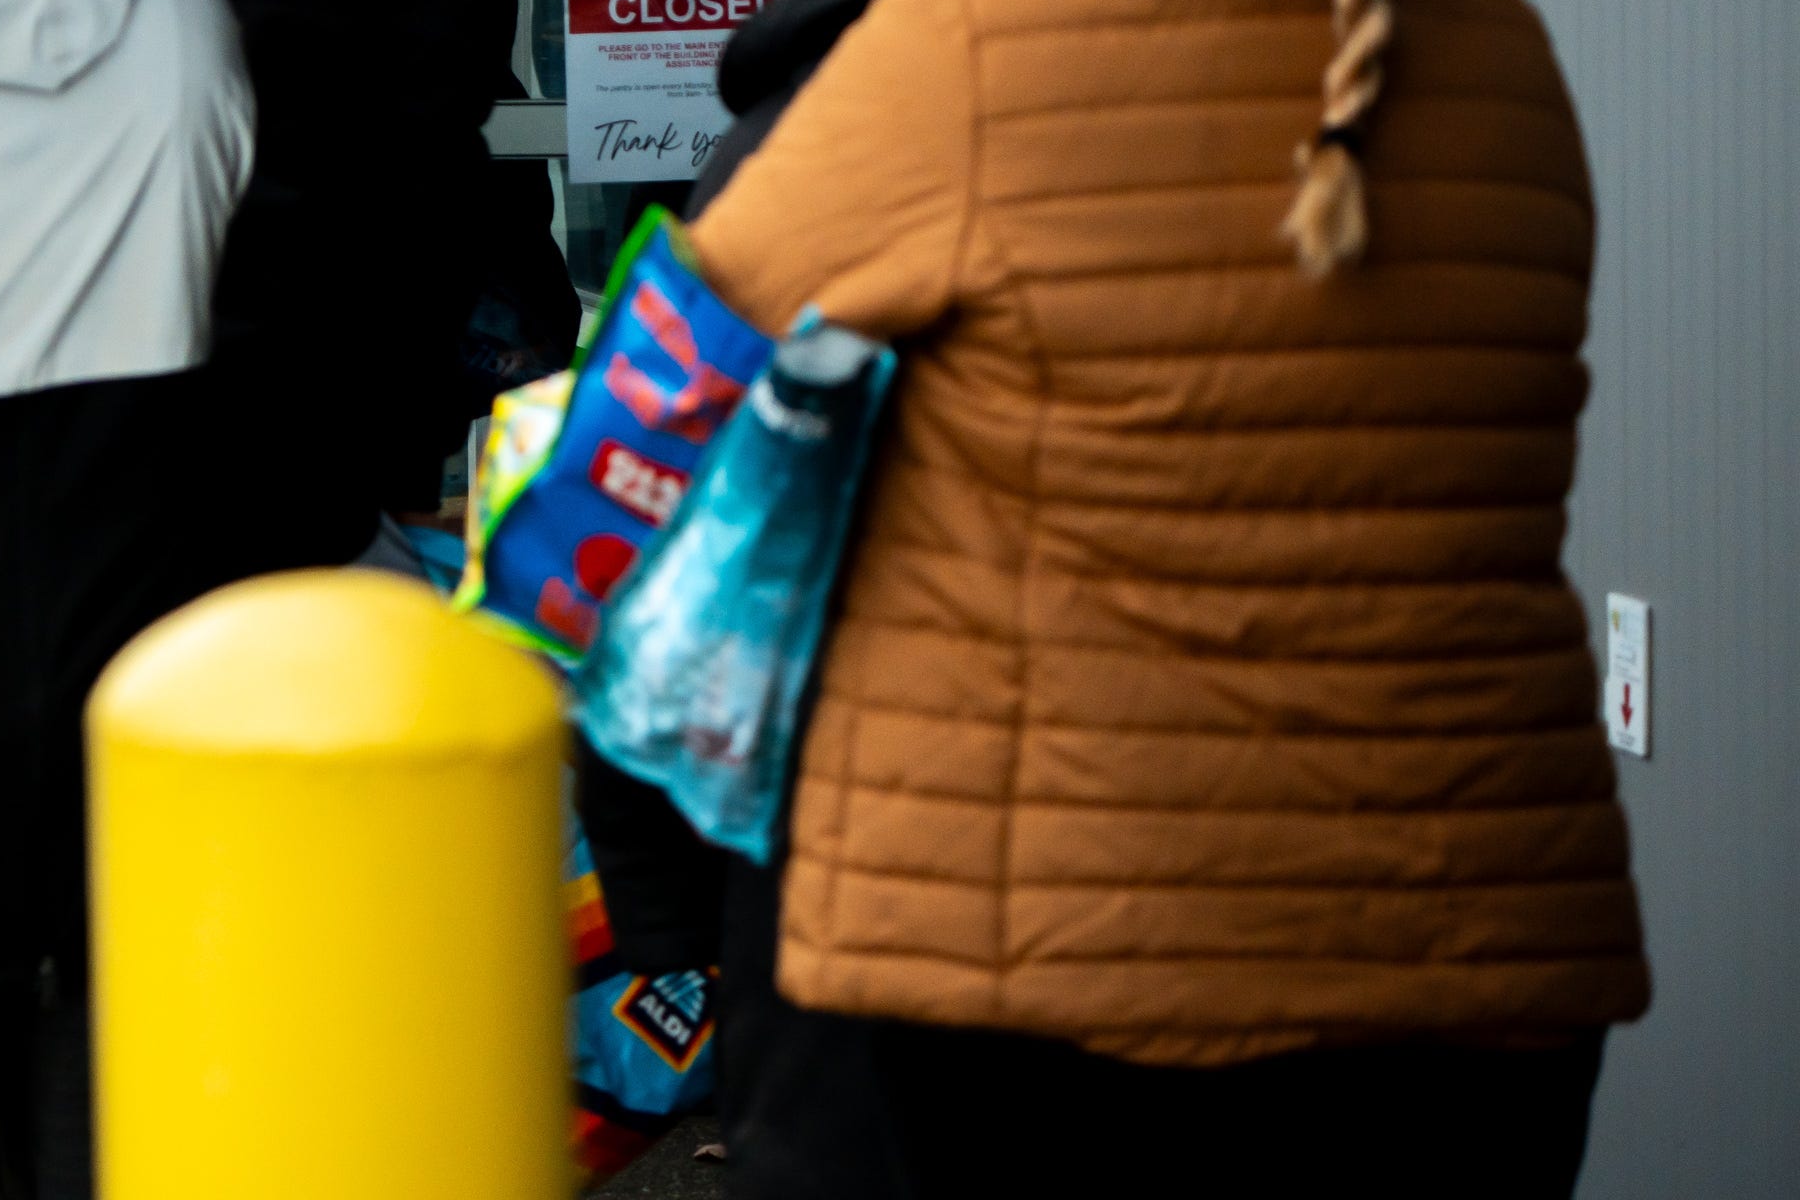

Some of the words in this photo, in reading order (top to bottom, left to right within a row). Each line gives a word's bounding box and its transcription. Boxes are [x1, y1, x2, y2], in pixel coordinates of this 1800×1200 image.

[598, 43, 633, 53] PLEASE
[634, 43, 650, 52] GO
[651, 42, 664, 51] TO
[664, 42, 681, 51] THE
[684, 41, 706, 50] MAIN
[608, 52, 639, 62] FRONT
[639, 51, 652, 61] OF
[655, 51, 672, 60] THE
[673, 50, 716, 60] BUILDING
[594, 119, 683, 161] Thank
[691, 128, 724, 168] yo
[637, 993, 692, 1046] ALDI
